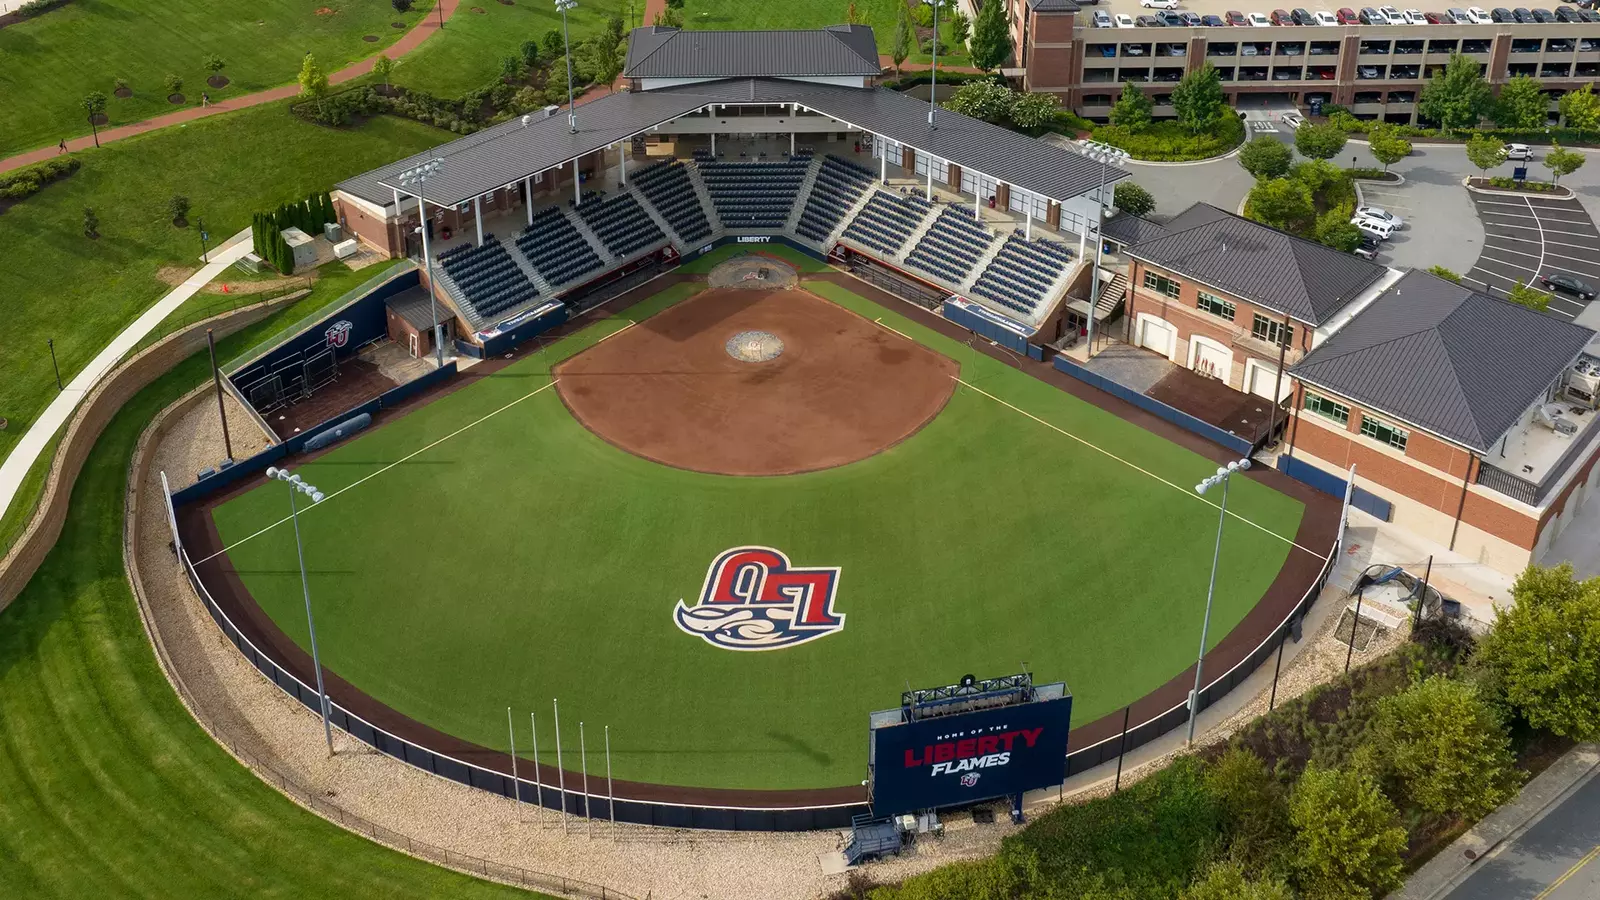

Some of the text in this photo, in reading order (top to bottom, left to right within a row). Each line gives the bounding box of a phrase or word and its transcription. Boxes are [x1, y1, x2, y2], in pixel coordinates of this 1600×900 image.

[904, 727, 1043, 768] LIBERTY
[937, 731, 964, 740] HOME
[931, 752, 1011, 777] FLAMES
